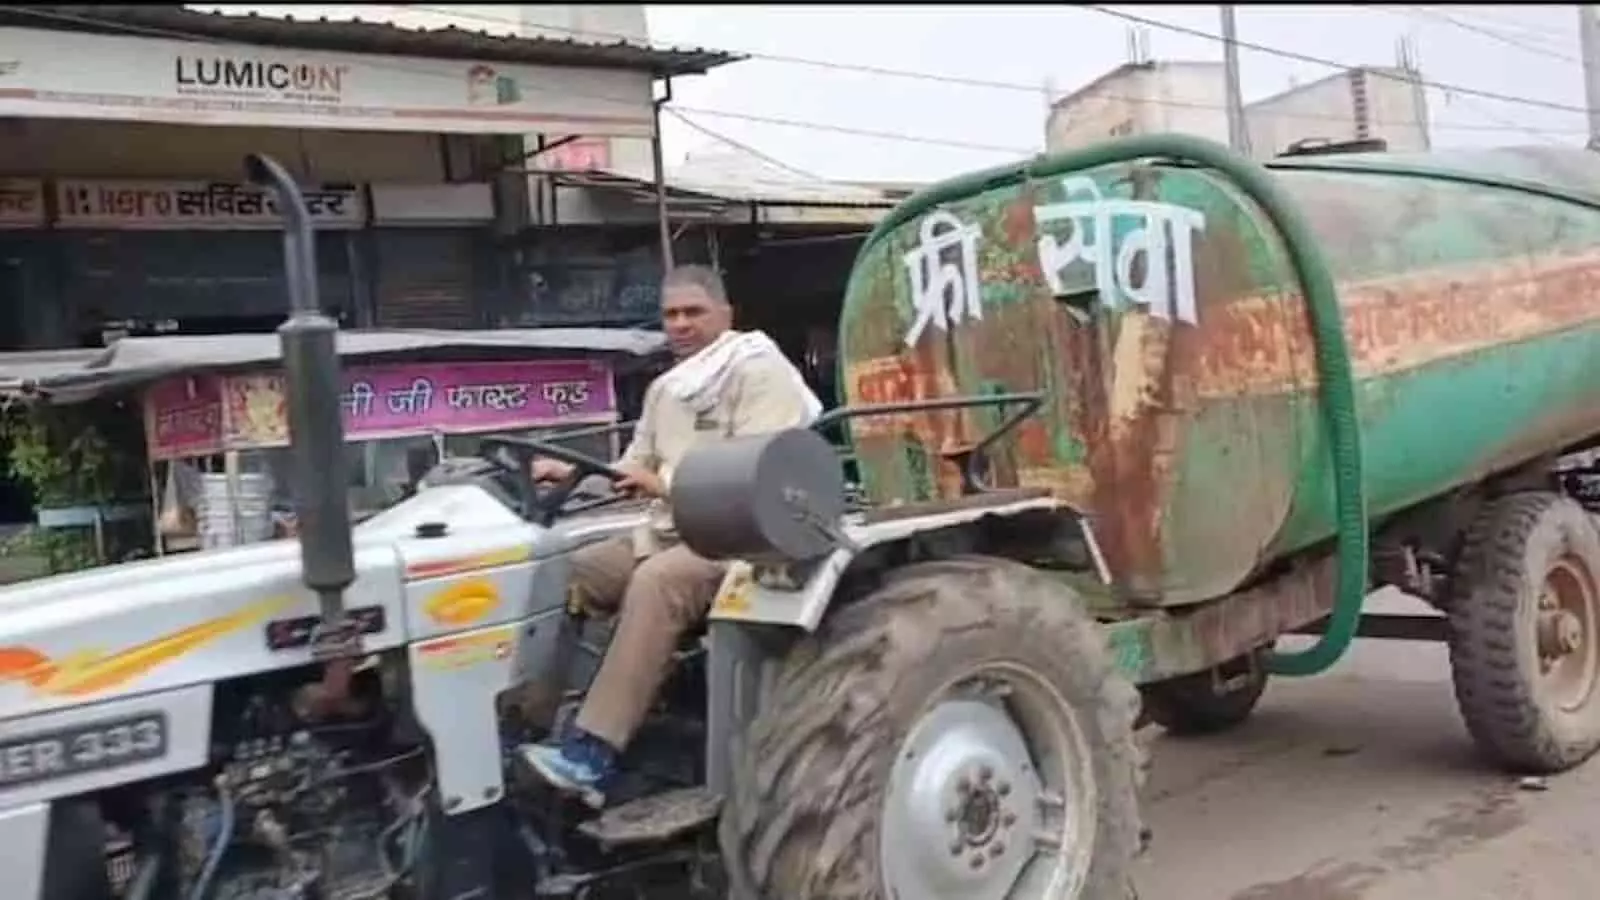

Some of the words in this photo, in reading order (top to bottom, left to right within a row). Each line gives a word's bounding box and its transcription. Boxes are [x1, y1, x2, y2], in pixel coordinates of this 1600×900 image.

[176, 56, 343, 93] LUMICON
[903, 211, 984, 348] फ्री
[1032, 177, 1206, 328] सेवा
[543, 380, 591, 415] फूड
[0, 740, 65, 778] ER
[72, 719, 161, 761] 333
